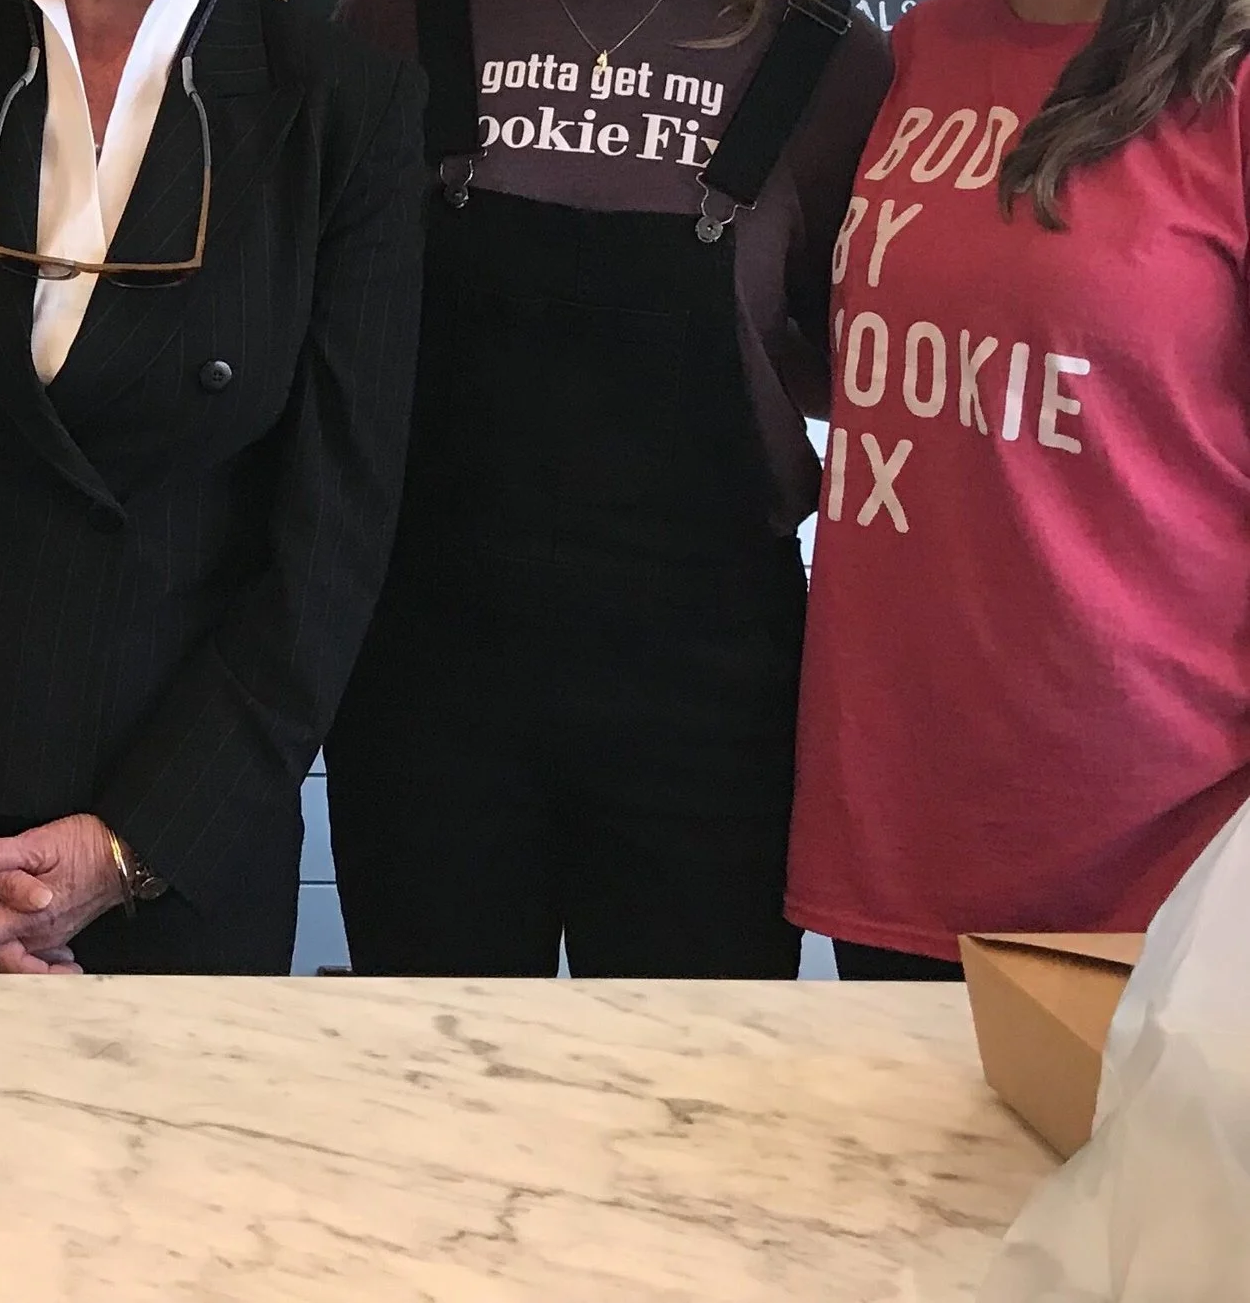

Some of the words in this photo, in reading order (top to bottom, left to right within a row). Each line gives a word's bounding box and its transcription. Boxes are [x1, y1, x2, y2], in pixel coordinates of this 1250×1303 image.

[481, 53, 579, 94] gotta
[590, 62, 654, 100] get
[663, 73, 725, 117] my
[834, 309, 1091, 455] OOKIE
